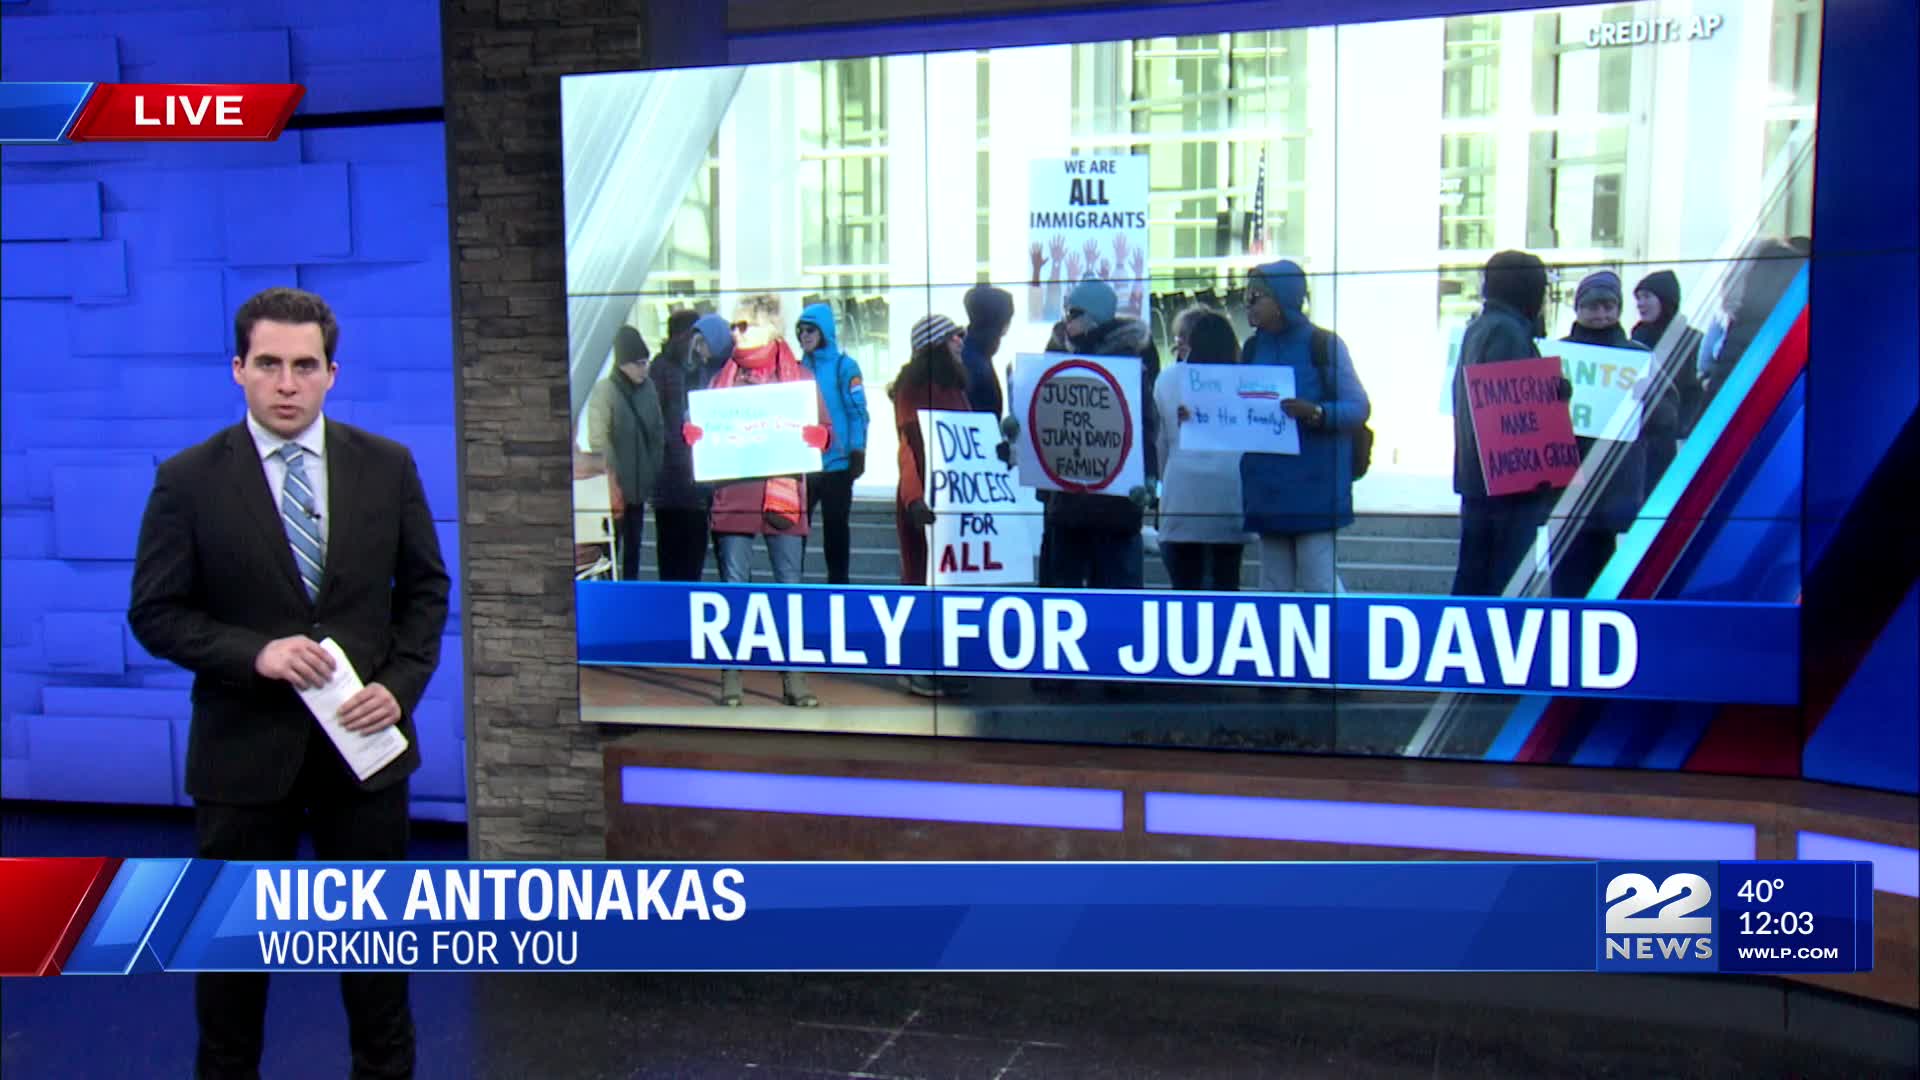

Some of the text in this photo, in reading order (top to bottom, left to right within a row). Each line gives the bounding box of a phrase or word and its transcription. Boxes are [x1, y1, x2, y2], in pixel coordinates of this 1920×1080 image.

[1585, 15, 1723, 48] CREDIT: AP
[1064, 160, 1117, 174] WE ARE
[1069, 178, 1109, 206] ALL
[1030, 211, 1146, 229] IMMIGRANTS
[1042, 382, 1111, 409] JUSTICE
[1063, 410, 1094, 430] FOR
[1501, 411, 1539, 435] MAKE
[936, 420, 986, 463] DUE
[1042, 427, 1121, 449] JUAN DAVID
[1056, 457, 1110, 478] FAMILY
[1488, 446, 1543, 479] AMERICA
[930, 469, 1016, 508] PROCESS
[960, 512, 998, 537] FOR
[939, 541, 1003, 573] ALL
[689, 591, 1638, 690] RALLY FOR JUAN DAVID
